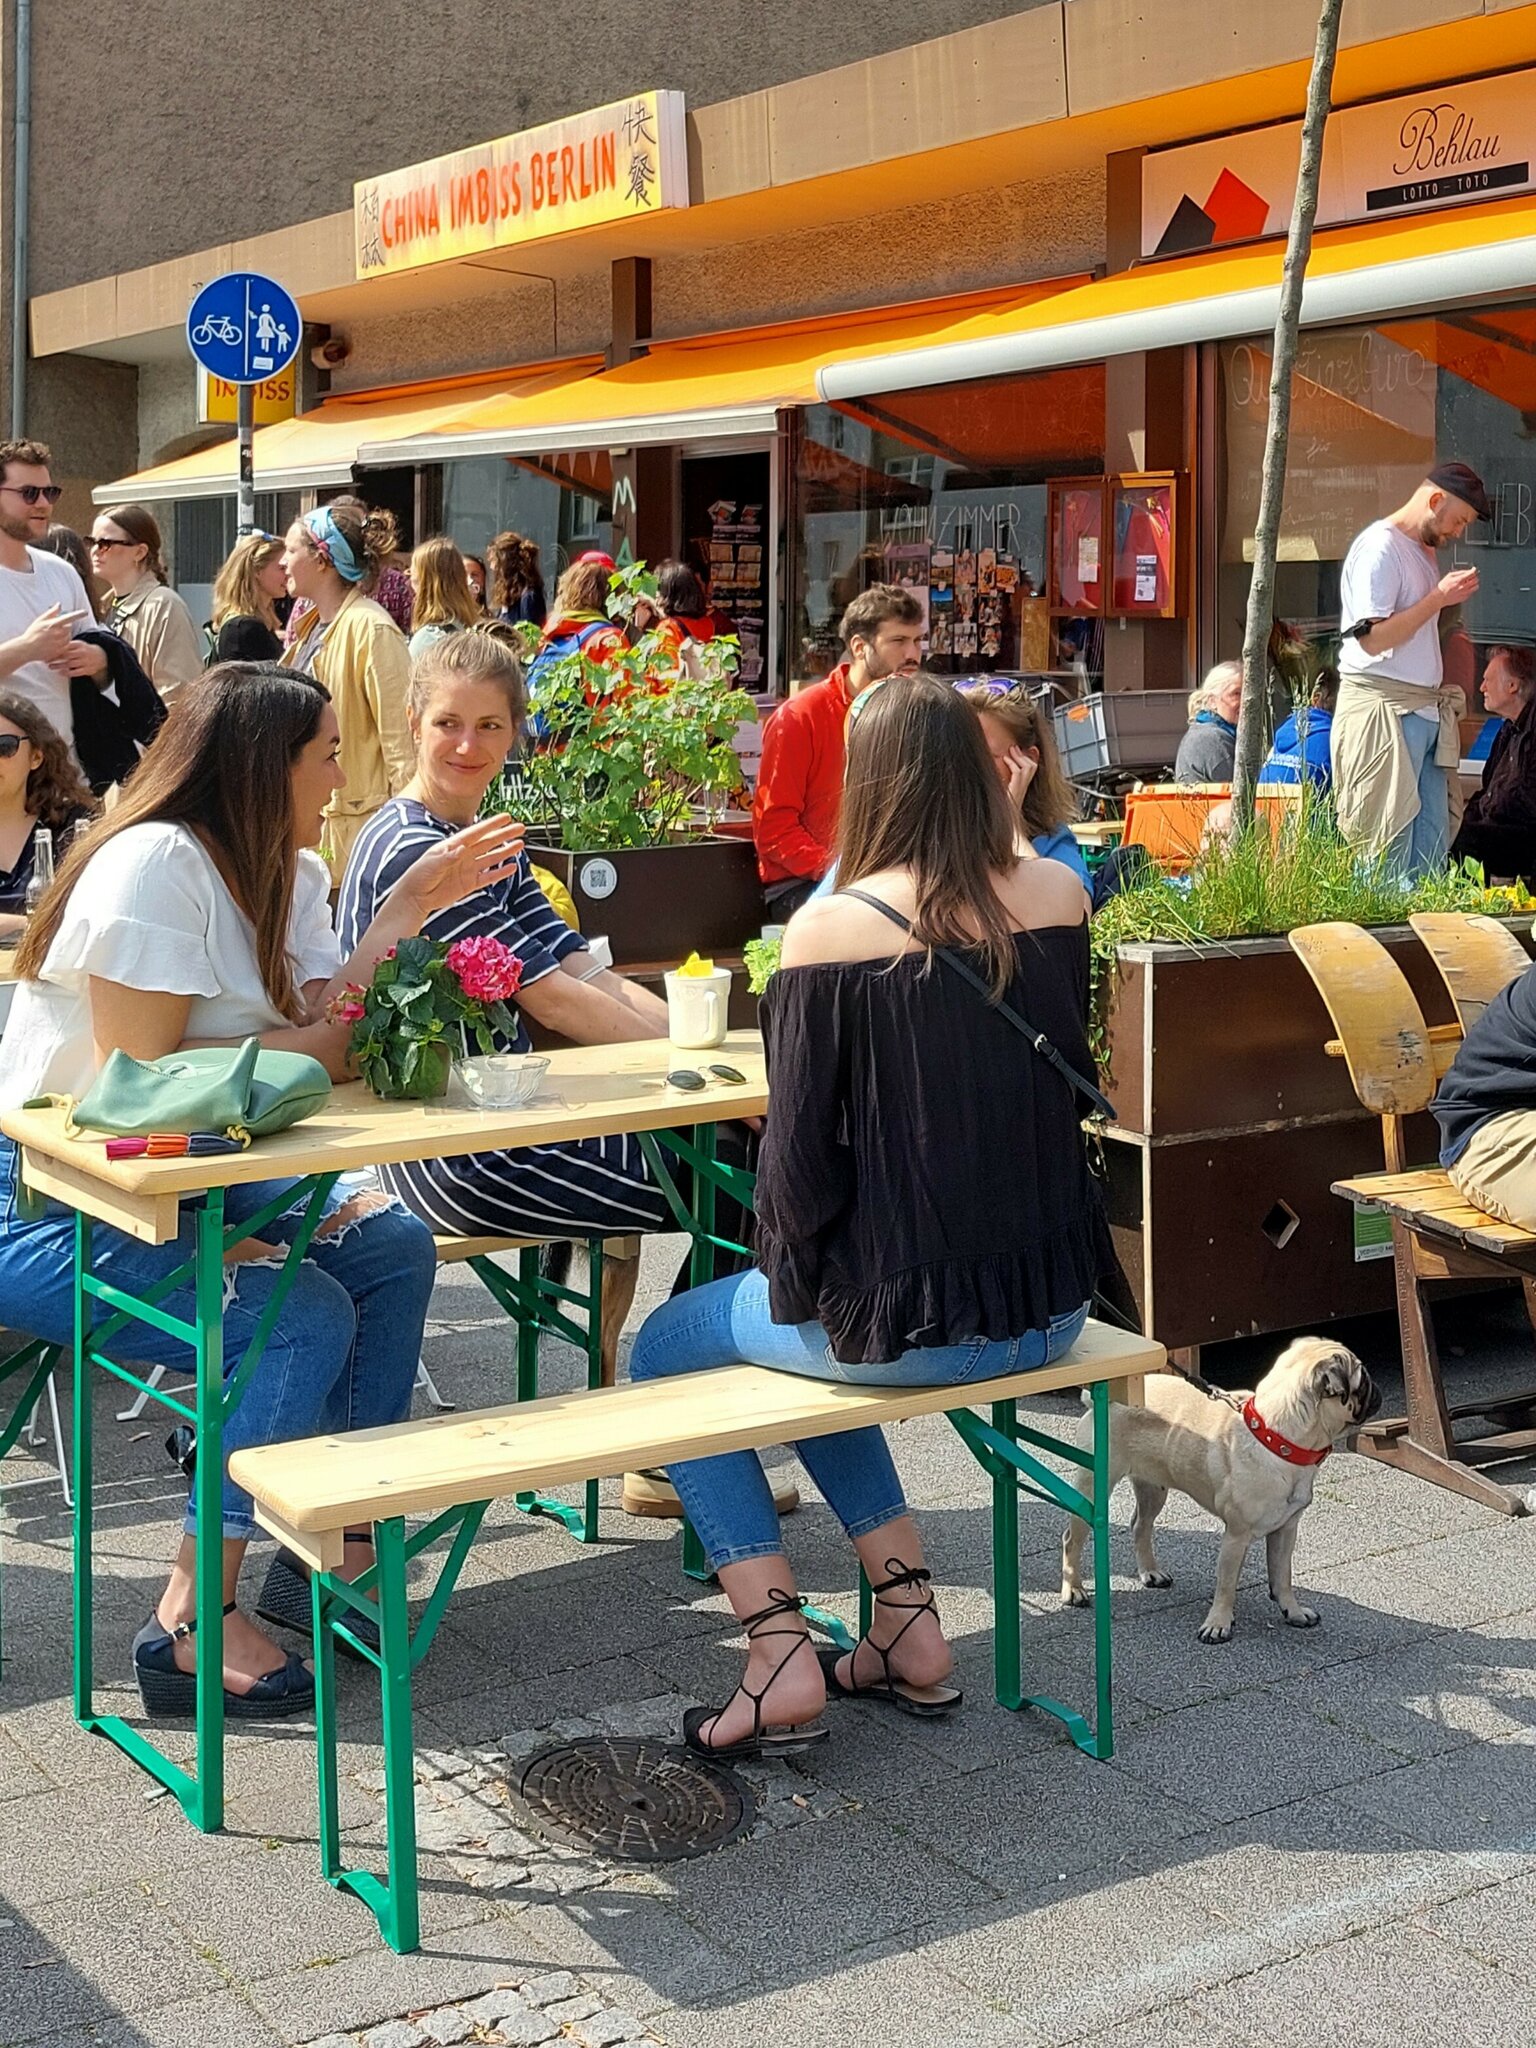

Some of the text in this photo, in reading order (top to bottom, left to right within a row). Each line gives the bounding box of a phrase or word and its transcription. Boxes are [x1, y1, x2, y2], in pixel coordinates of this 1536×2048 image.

[621, 101, 656, 208] 快餐
[1393, 104, 1500, 175] Behlau
[382, 131, 616, 249] CHINA IMBISS BERLIN
[1402, 182, 1439, 201] LOTTO
[1458, 173, 1489, 191] TOTO
